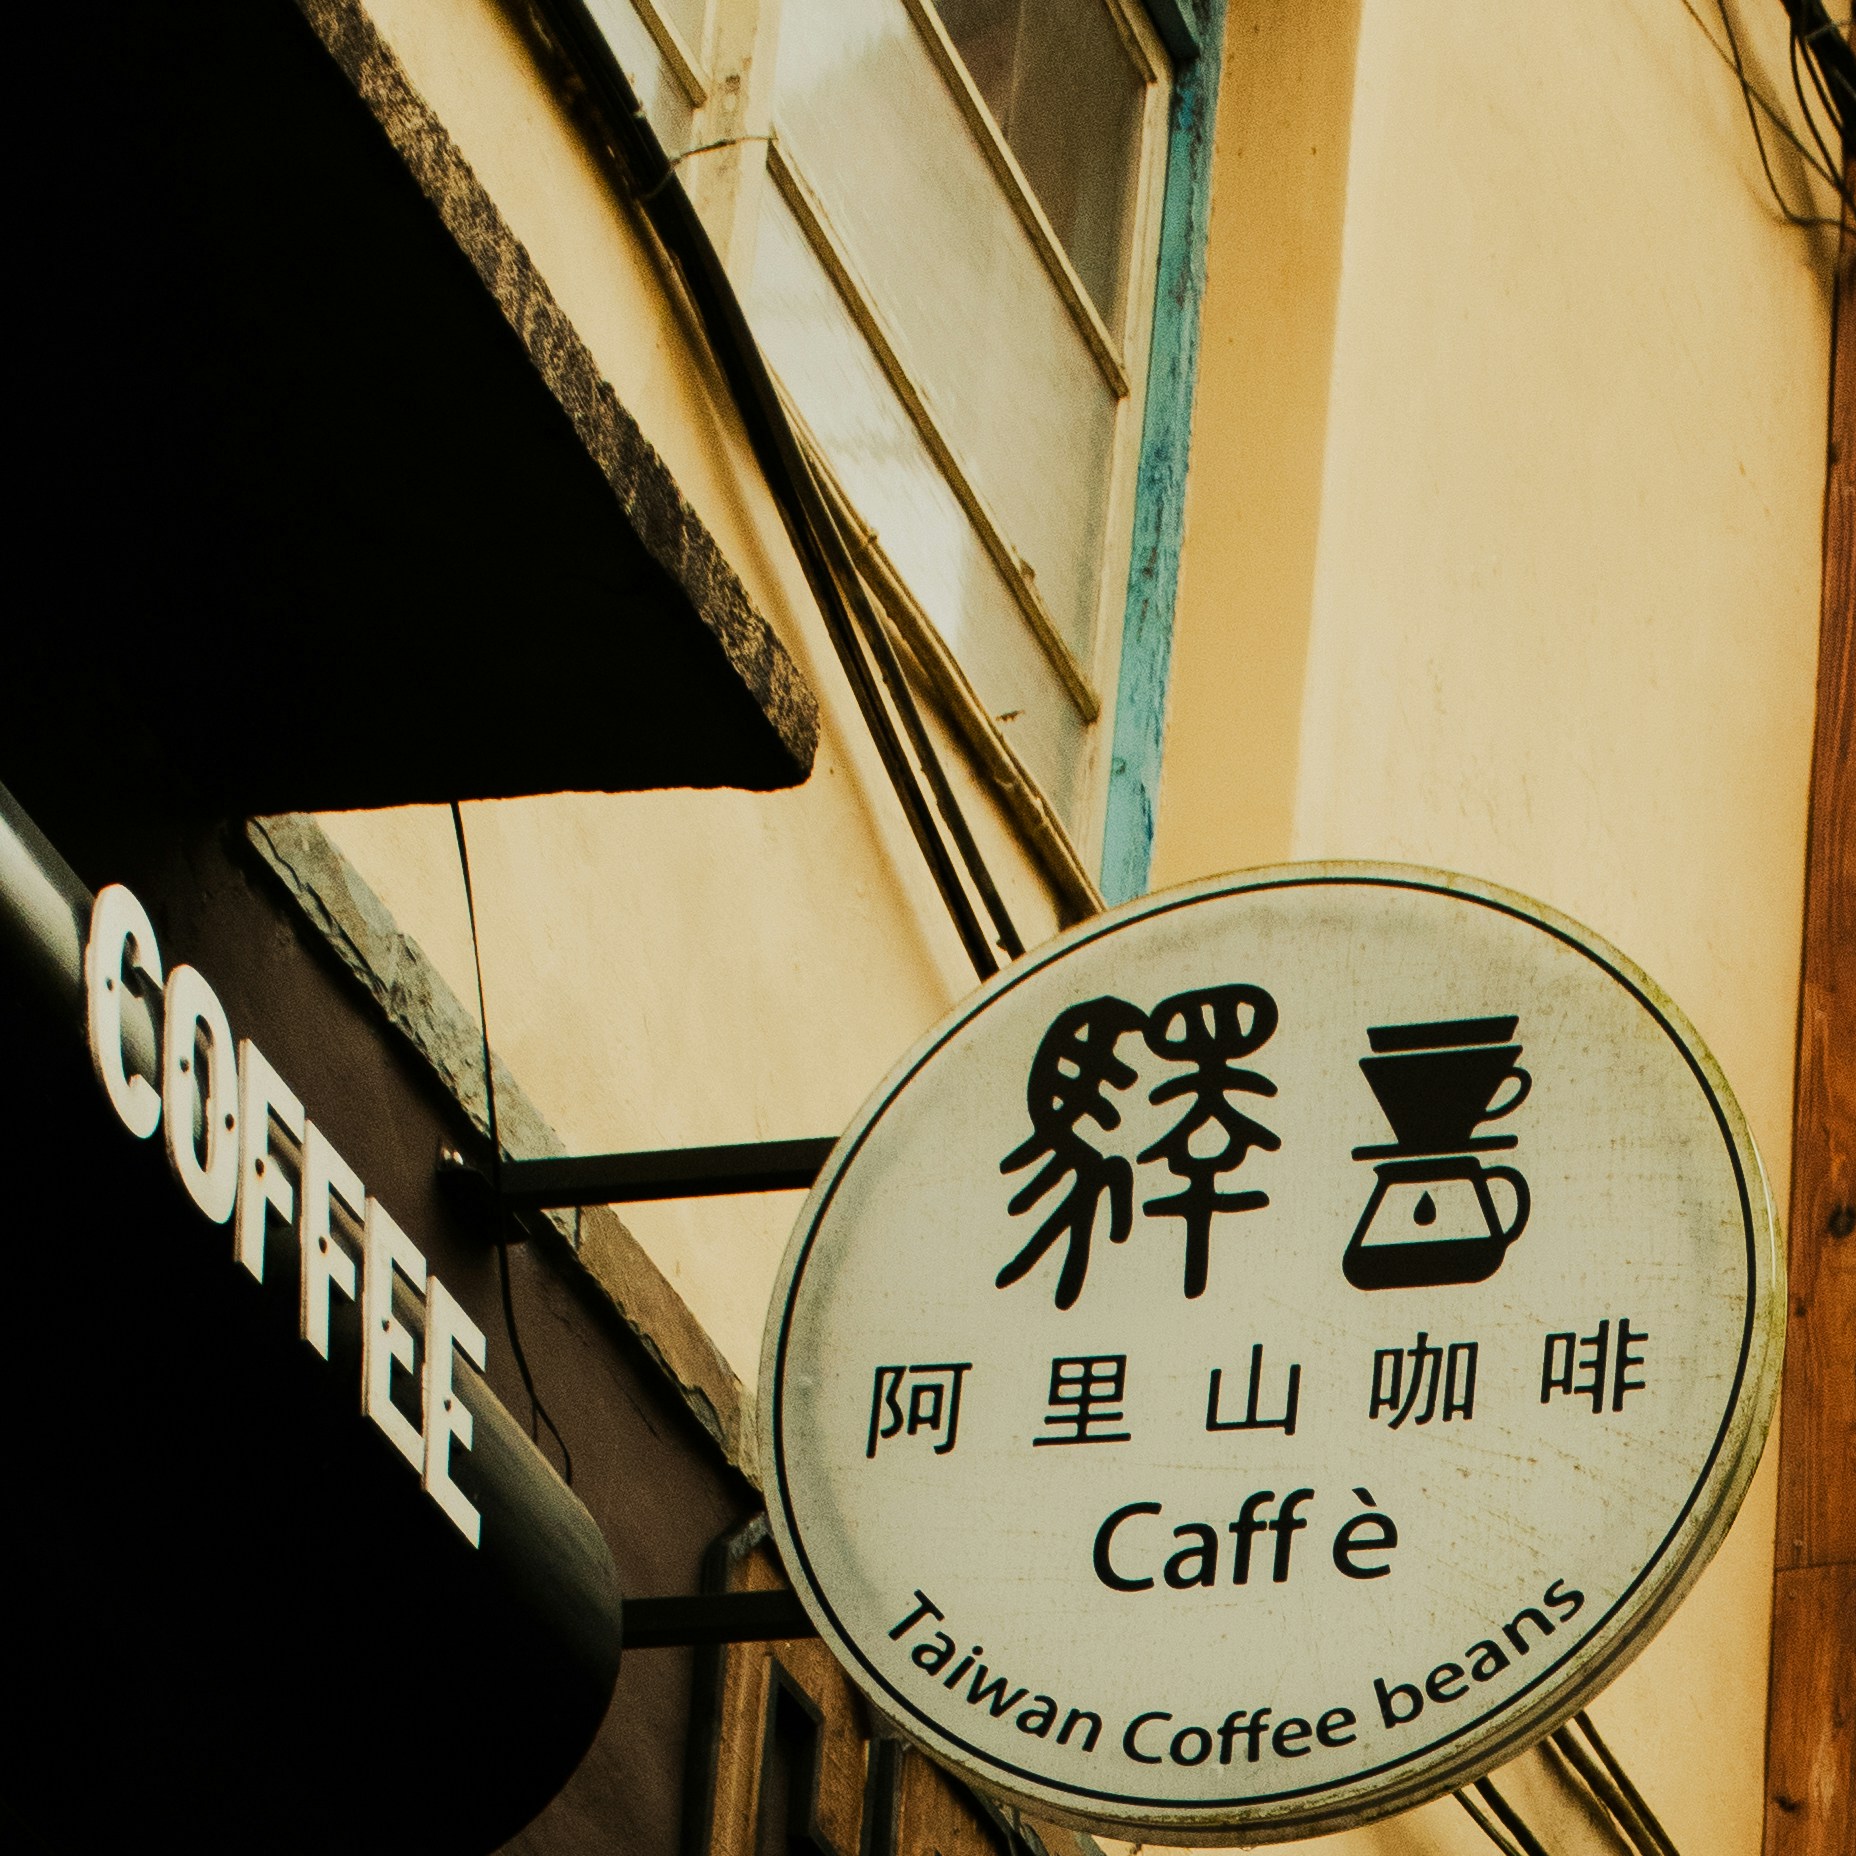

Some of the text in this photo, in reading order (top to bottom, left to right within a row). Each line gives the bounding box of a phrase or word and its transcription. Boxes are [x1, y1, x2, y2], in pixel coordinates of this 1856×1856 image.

[85, 883, 487, 1549] COFFEE
[865, 1318, 1649, 1459] 阿里山咖啡
[1093, 1487, 1398, 1592] Caffè
[887, 1577, 1587, 1766] Taiwan Coffee beans
